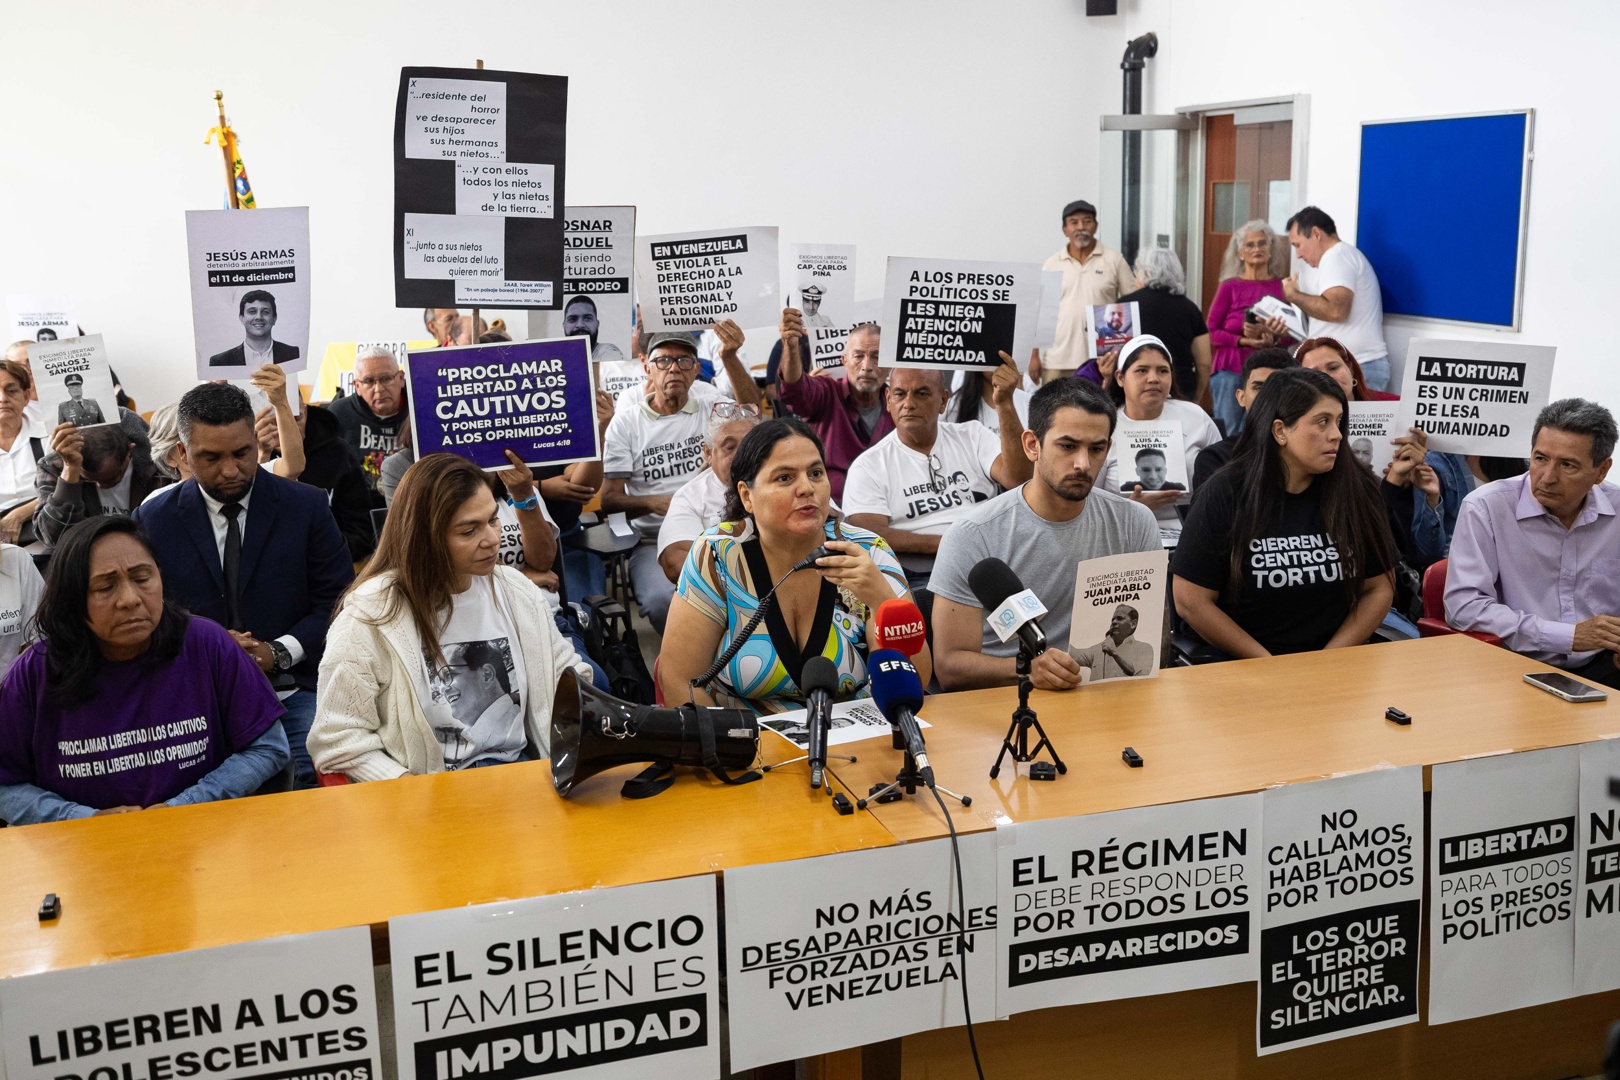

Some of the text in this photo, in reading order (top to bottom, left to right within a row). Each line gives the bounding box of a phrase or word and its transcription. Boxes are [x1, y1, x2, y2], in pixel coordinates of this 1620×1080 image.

[470, 94, 486, 102] del
[471, 106, 500, 114] horror
[432, 115, 495, 125] desaparecer
[443, 126, 465, 135] hijos
[449, 138, 498, 147] hermanas
[505, 166, 528, 175] ellos
[463, 177, 541, 188] todos los nietos
[493, 192, 549, 201] y las nietas
[481, 203, 495, 211] de
[498, 204, 507, 212] la
[564, 220, 612, 230] OSNAR
[564, 237, 613, 247] ADUEL
[654, 239, 743, 257] EN VENEZUELA
[206, 249, 295, 261] JESÚS ARMAS
[241, 259, 294, 268] arbitrariamente
[424, 254, 498, 264] las abuelas del luto
[575, 253, 611, 262] siendo
[656, 256, 727, 271] SE VIOLA EL
[210, 275, 219, 283] el
[232, 274, 244, 282] de
[247, 272, 294, 281] diciembre
[449, 268, 478, 277] quieren
[657, 266, 743, 283] DERECHO A LA
[910, 271, 1014, 286] A LOS PRESOS
[579, 282, 620, 291] RODEO
[659, 280, 732, 294] INTEGRIDAD
[909, 284, 1009, 301] POLÍTICOS SE
[660, 291, 733, 305] PERSONAL Y
[662, 303, 738, 316] LA DIGNIDAD
[907, 303, 985, 318] LES NIEGA
[905, 318, 982, 333] ATENCIÓN
[904, 331, 963, 347] MÉDICA
[903, 347, 986, 363] ADECUADA
[45, 359, 80, 369] CARLOS
[1420, 361, 1519, 381] LA TORTURA
[438, 374, 567, 398] LIBERTAD A LOS
[1418, 385, 1529, 404] ES UN CRIMEN
[436, 390, 566, 419] CAUTIVOS
[1416, 403, 1480, 418] DE LESA
[441, 412, 567, 432] Y PONER EN LIBERTAD
[1414, 420, 1510, 437] HUMANIDAD
[442, 435, 452, 446] A
[456, 432, 482, 444] LOS
[643, 443, 674, 457] LIBEREN
[684, 433, 704, 446] TODOS
[906, 490, 962, 519] JESÚS
[1249, 534, 1324, 552] CIERREN
[1251, 547, 1339, 568] CENTROS
[1087, 568, 1154, 583] EXIGIMOS LIBERTAD
[1090, 579, 1126, 589] INMEDIATA
[1084, 582, 1151, 599] JUAN PABLO
[1092, 593, 1140, 606] GUANIPA
[884, 621, 923, 637] NTN24
[1321, 809, 1357, 833] NO
[1268, 824, 1412, 866] CALLAMOS,
[1444, 823, 1568, 864] LIBERTAD
[1012, 828, 1247, 887] EL RÉGIMEN
[1269, 845, 1412, 890] HABLAMOS
[1441, 857, 1572, 898] PARA TODOS
[1015, 863, 1244, 912] DEBE RESPONDER
[1268, 867, 1414, 912] POR TODOS
[816, 888, 932, 928] NO MÁS
[1442, 897, 1484, 920] LOS
[1491, 879, 1572, 911] PRESOS
[1014, 885, 1249, 937] POR TODOS LOS
[1443, 901, 1571, 944] POLÍTICOS
[742, 905, 997, 968] DESAPARICIONES
[1292, 914, 1399, 955] LOS QUE
[414, 915, 704, 988] EL SILENCIO
[1018, 924, 1240, 974] DESAPARECIDOS
[769, 934, 974, 989] FORZADAS EN
[1272, 937, 1406, 983] EL TERROR
[785, 962, 959, 1011] VENEZUELA
[1292, 964, 1384, 1004] QUIERE
[412, 956, 706, 1032] TAMBIÉN ES
[1271, 984, 1405, 1030] SILENCIAR.
[29, 985, 358, 1066] LIBEREN A LOS
[435, 1008, 701, 1080] IMPUNIDAD
